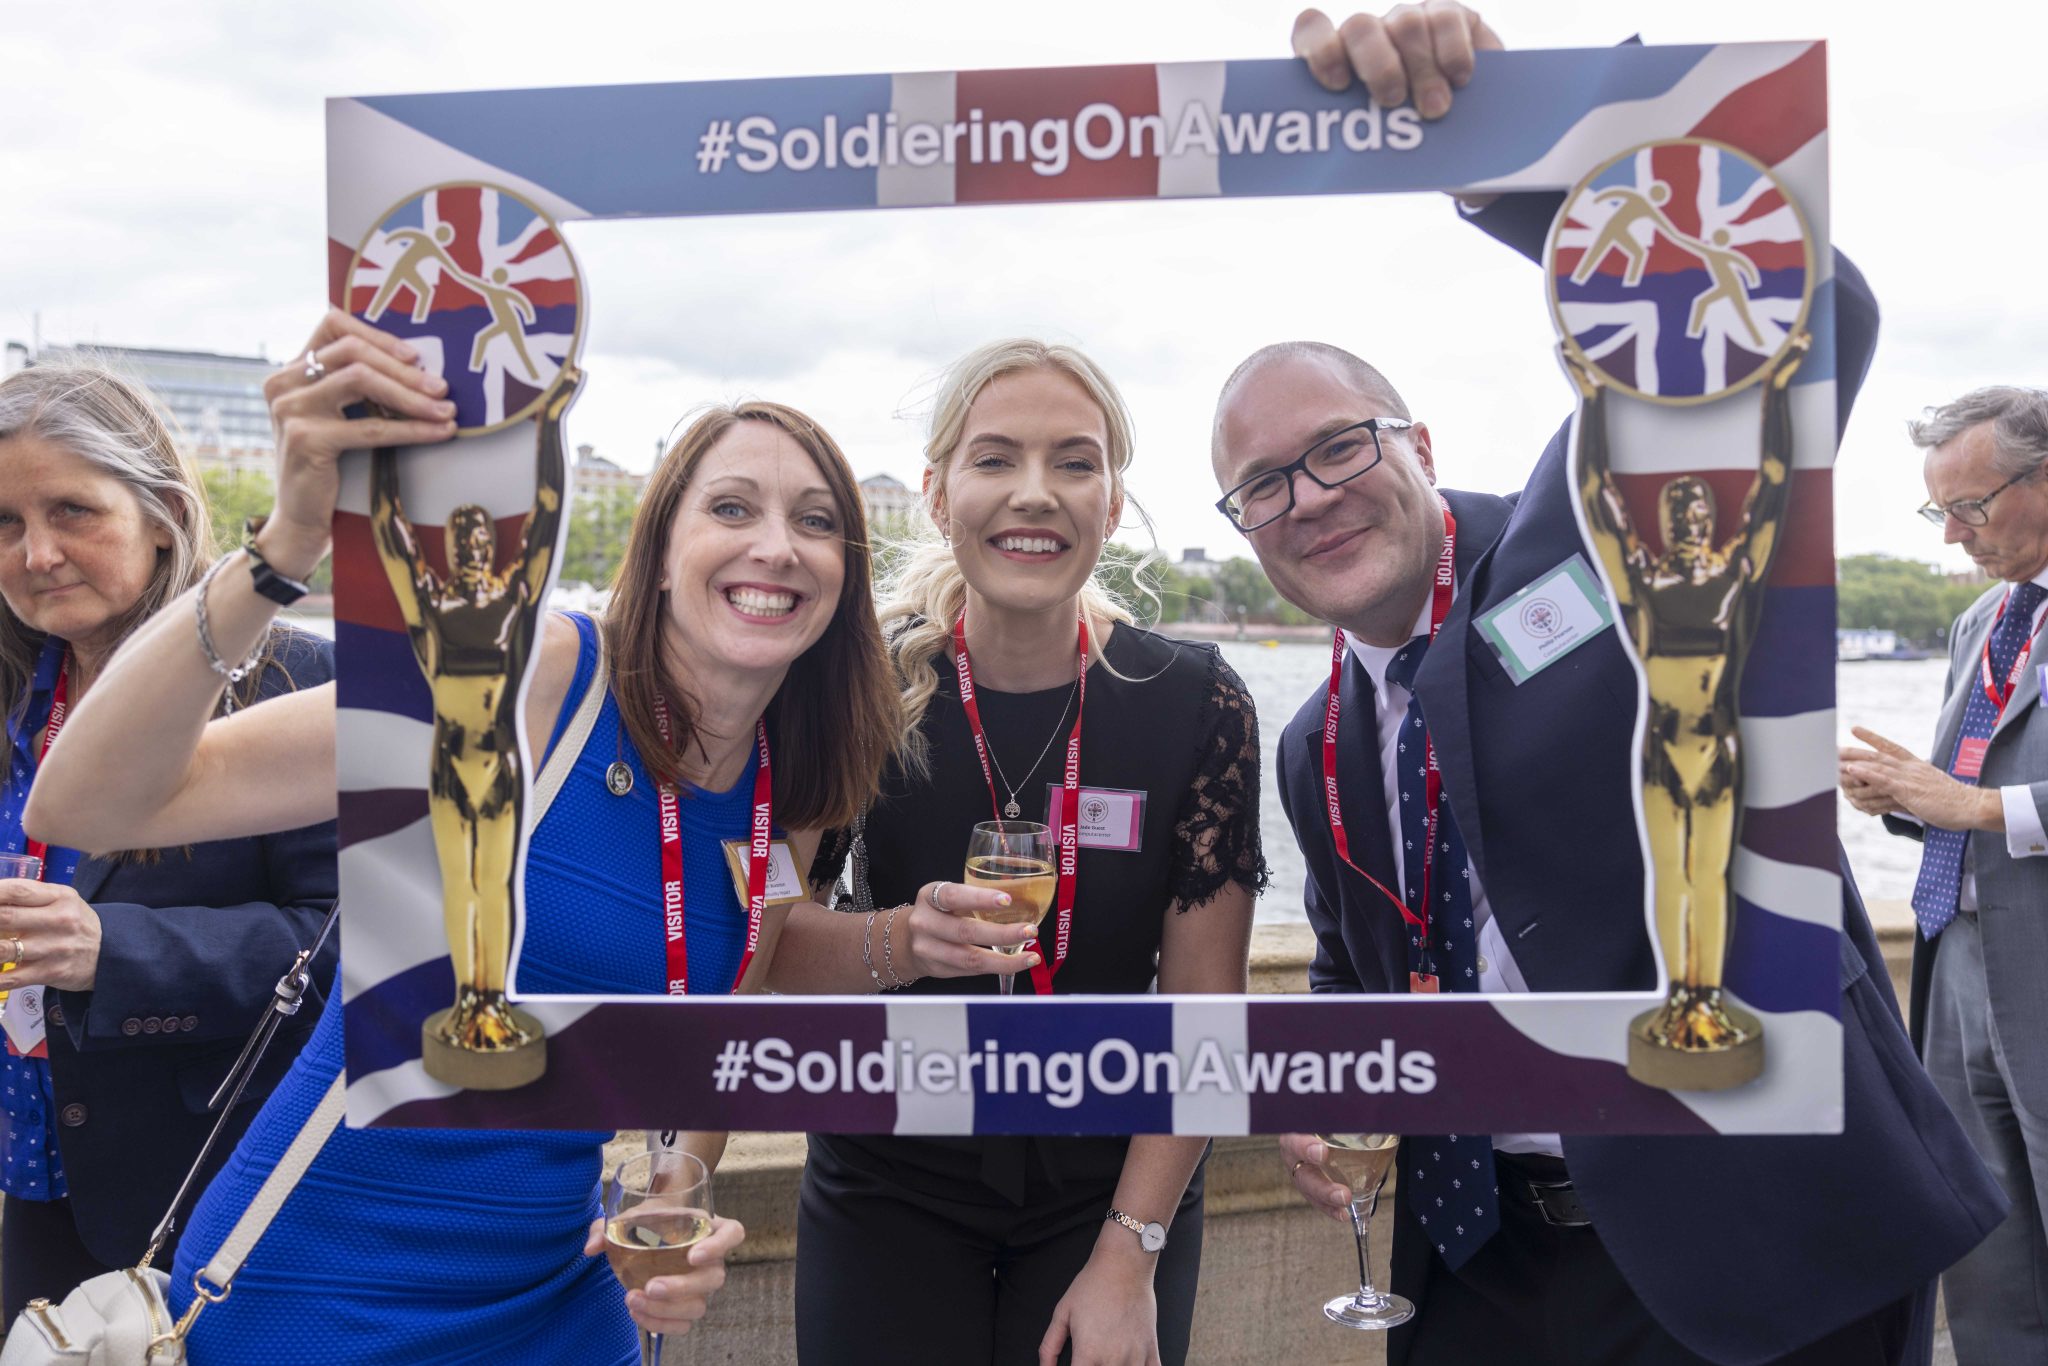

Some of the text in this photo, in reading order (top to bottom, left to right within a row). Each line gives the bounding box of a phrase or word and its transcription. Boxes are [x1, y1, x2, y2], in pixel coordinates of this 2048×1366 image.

[695, 98, 1424, 176] #SoldieringOnAwards
[1436, 534, 1454, 587] VISITOR
[1333, 626, 1345, 663] VISIT
[956, 651, 973, 704] VISITOR
[757, 714, 769, 769] ISITOR
[1325, 693, 1341, 744] VISITOR
[974, 733, 991, 785] VISITOR
[1065, 737, 1079, 790] VISITOR
[1326, 775, 1343, 827] VISITOR
[752, 802, 770, 858] VISITOR
[1061, 823, 1076, 877] VISITOR
[1426, 807, 1438, 866] VISITOR
[665, 879, 684, 943] VISITOR
[747, 894, 764, 953] VISITOR
[1056, 908, 1071, 961] VISITOR
[712, 1037, 1438, 1108] #SoldieringOnAwards
